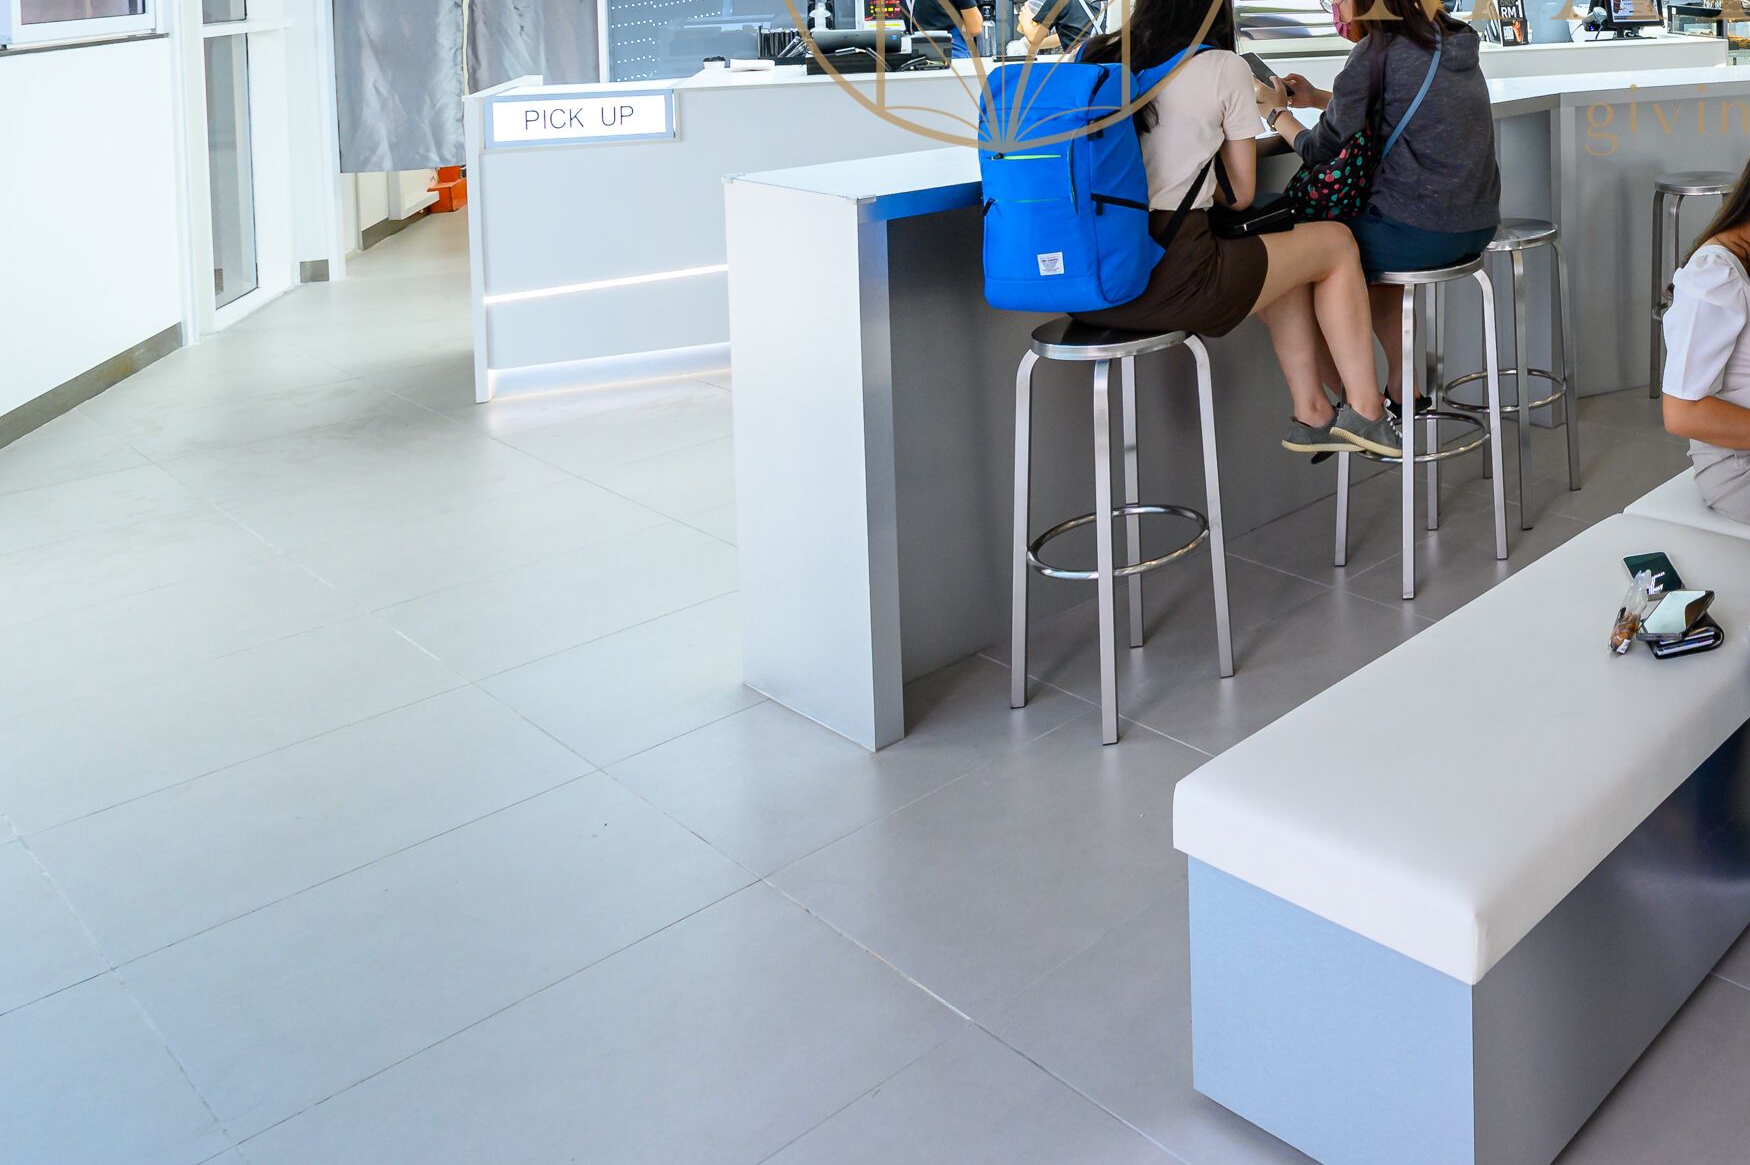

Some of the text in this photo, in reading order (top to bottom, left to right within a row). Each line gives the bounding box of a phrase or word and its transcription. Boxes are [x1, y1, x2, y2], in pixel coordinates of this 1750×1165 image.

[1500, 0, 1516, 7] ONLY
[524, 104, 635, 131] PICK UP
